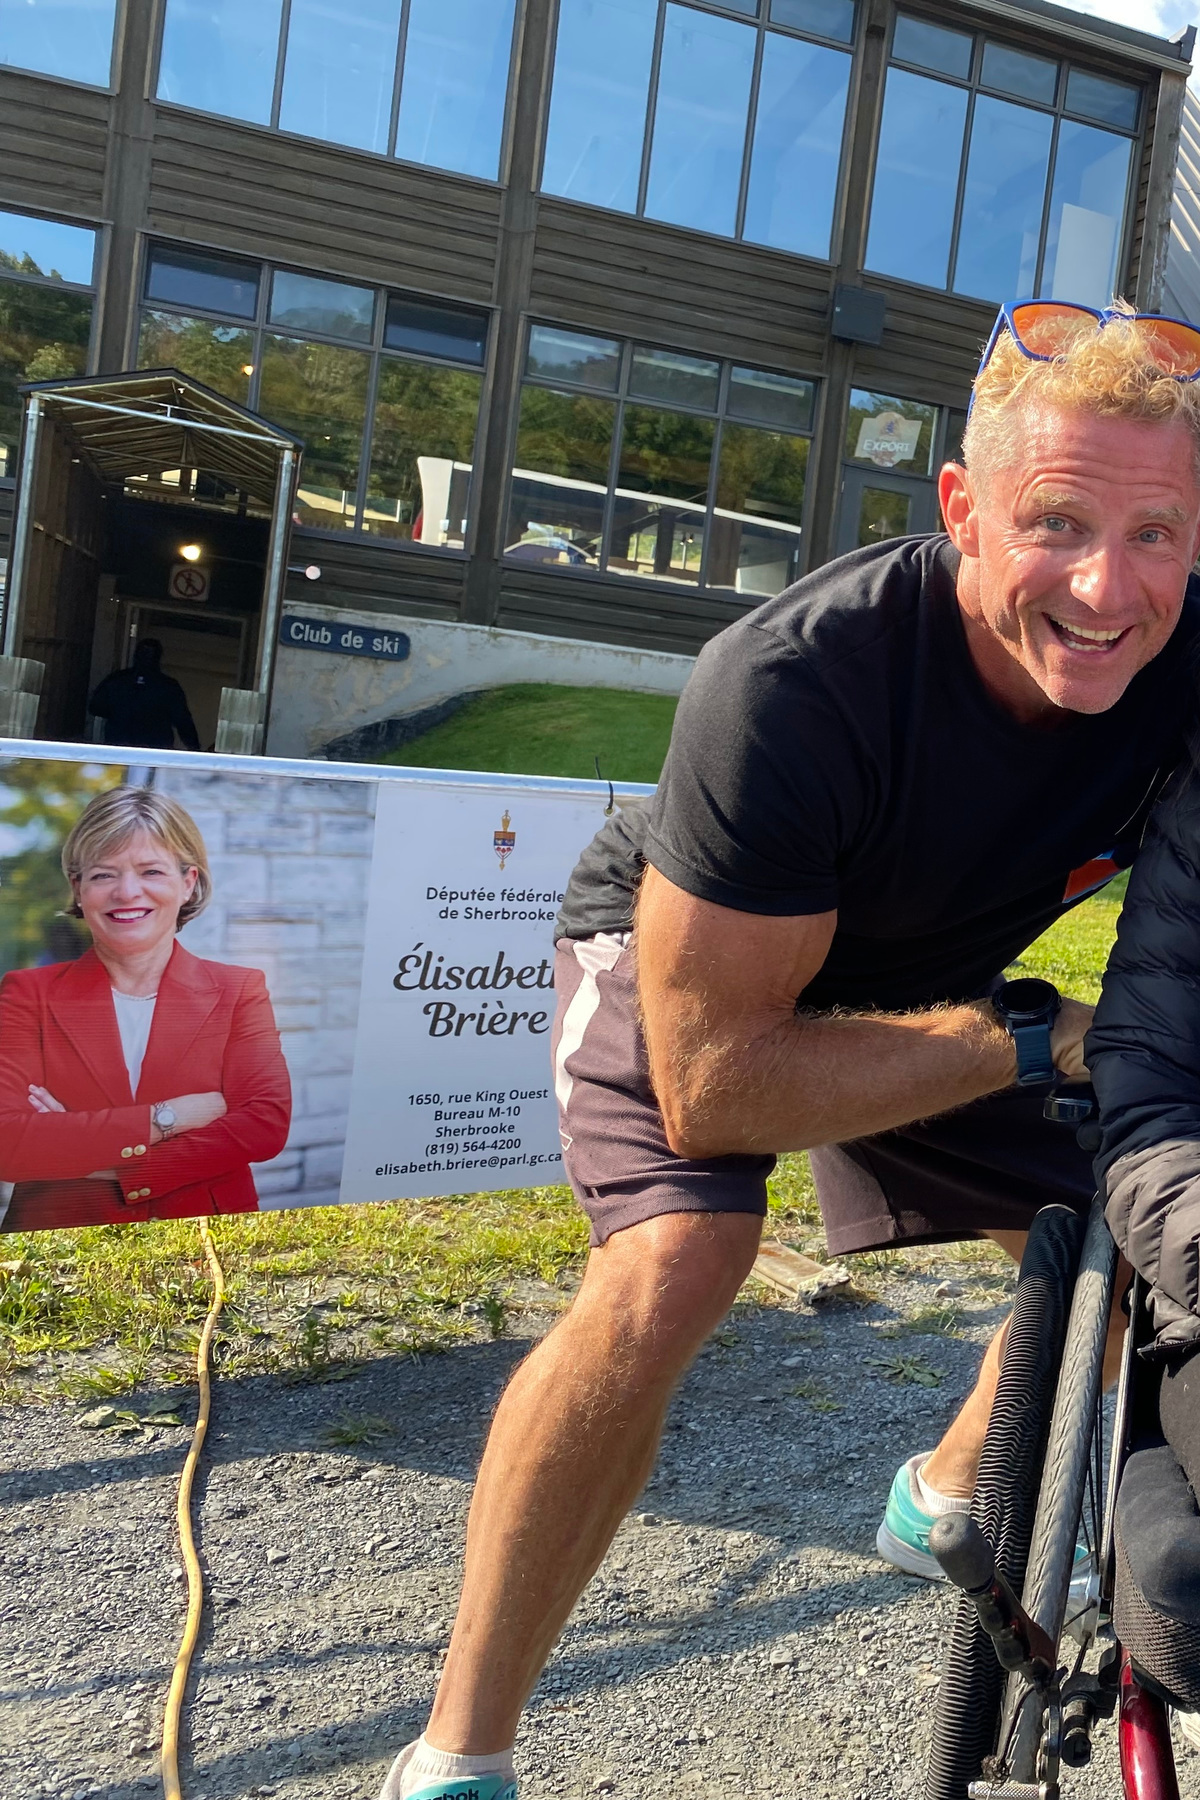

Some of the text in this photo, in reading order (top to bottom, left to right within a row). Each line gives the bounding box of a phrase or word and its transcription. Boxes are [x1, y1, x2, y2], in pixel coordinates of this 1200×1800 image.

[863, 440, 910, 452] EXPORT
[290, 622, 400, 654] Club de ski
[426, 886, 565, 903] Députée fédérale
[438, 907, 555, 921] de Sherbrooke
[423, 1000, 550, 1037] Brière
[408, 1088, 549, 1106] 1650, rue King Ouest
[434, 1105, 521, 1121] Bureau M-10
[435, 1123, 515, 1138] Sherbrooke
[425, 1138, 522, 1157] (819) 564-4200
[375, 1152, 562, 1176] elisabeth.briere@parl.gc.ca
